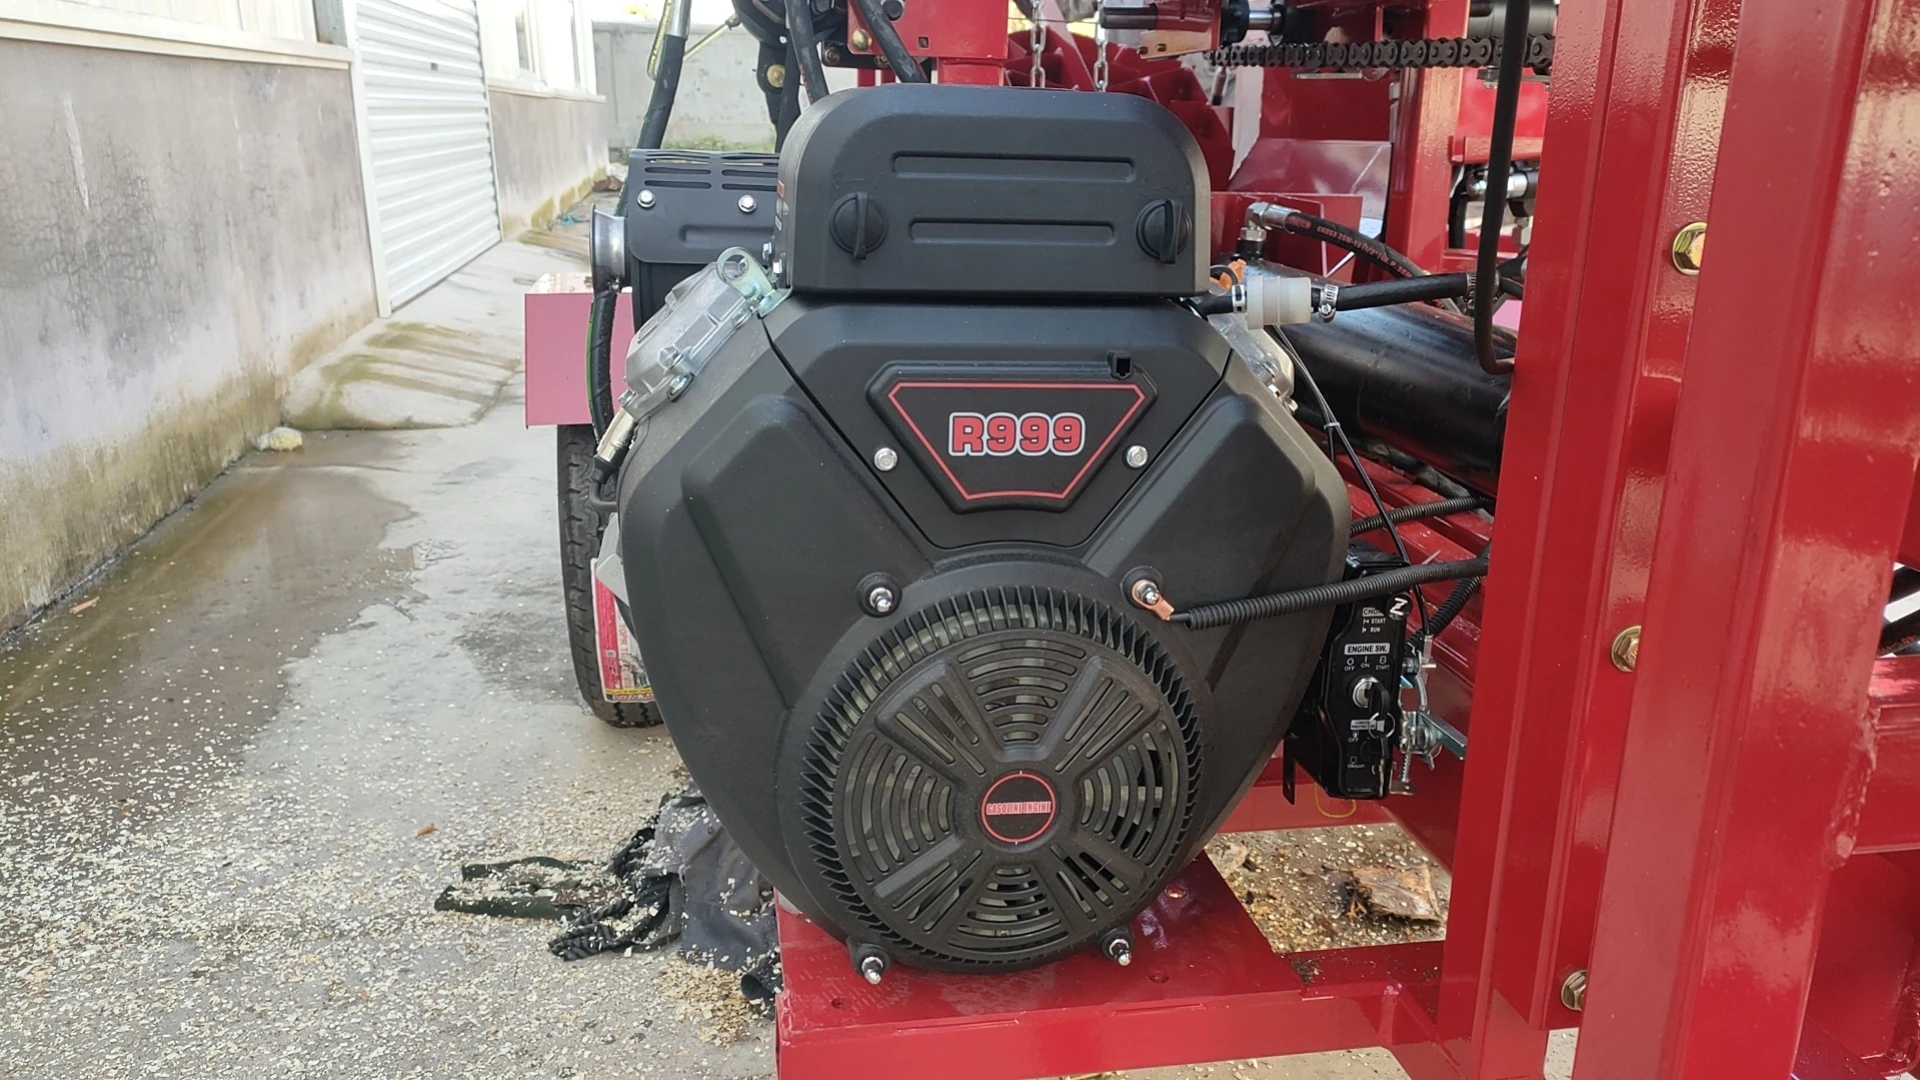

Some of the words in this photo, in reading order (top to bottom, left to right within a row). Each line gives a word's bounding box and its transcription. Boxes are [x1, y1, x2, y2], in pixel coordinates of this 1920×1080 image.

[948, 412, 1086, 456] R999
[1363, 608, 1384, 616] CHO
[1347, 645, 1374, 654] ENGINE
[1375, 644, 1388, 653] SW.
[986, 803, 1022, 816] GASOLINE
[1022, 801, 1051, 814] ENGINE
